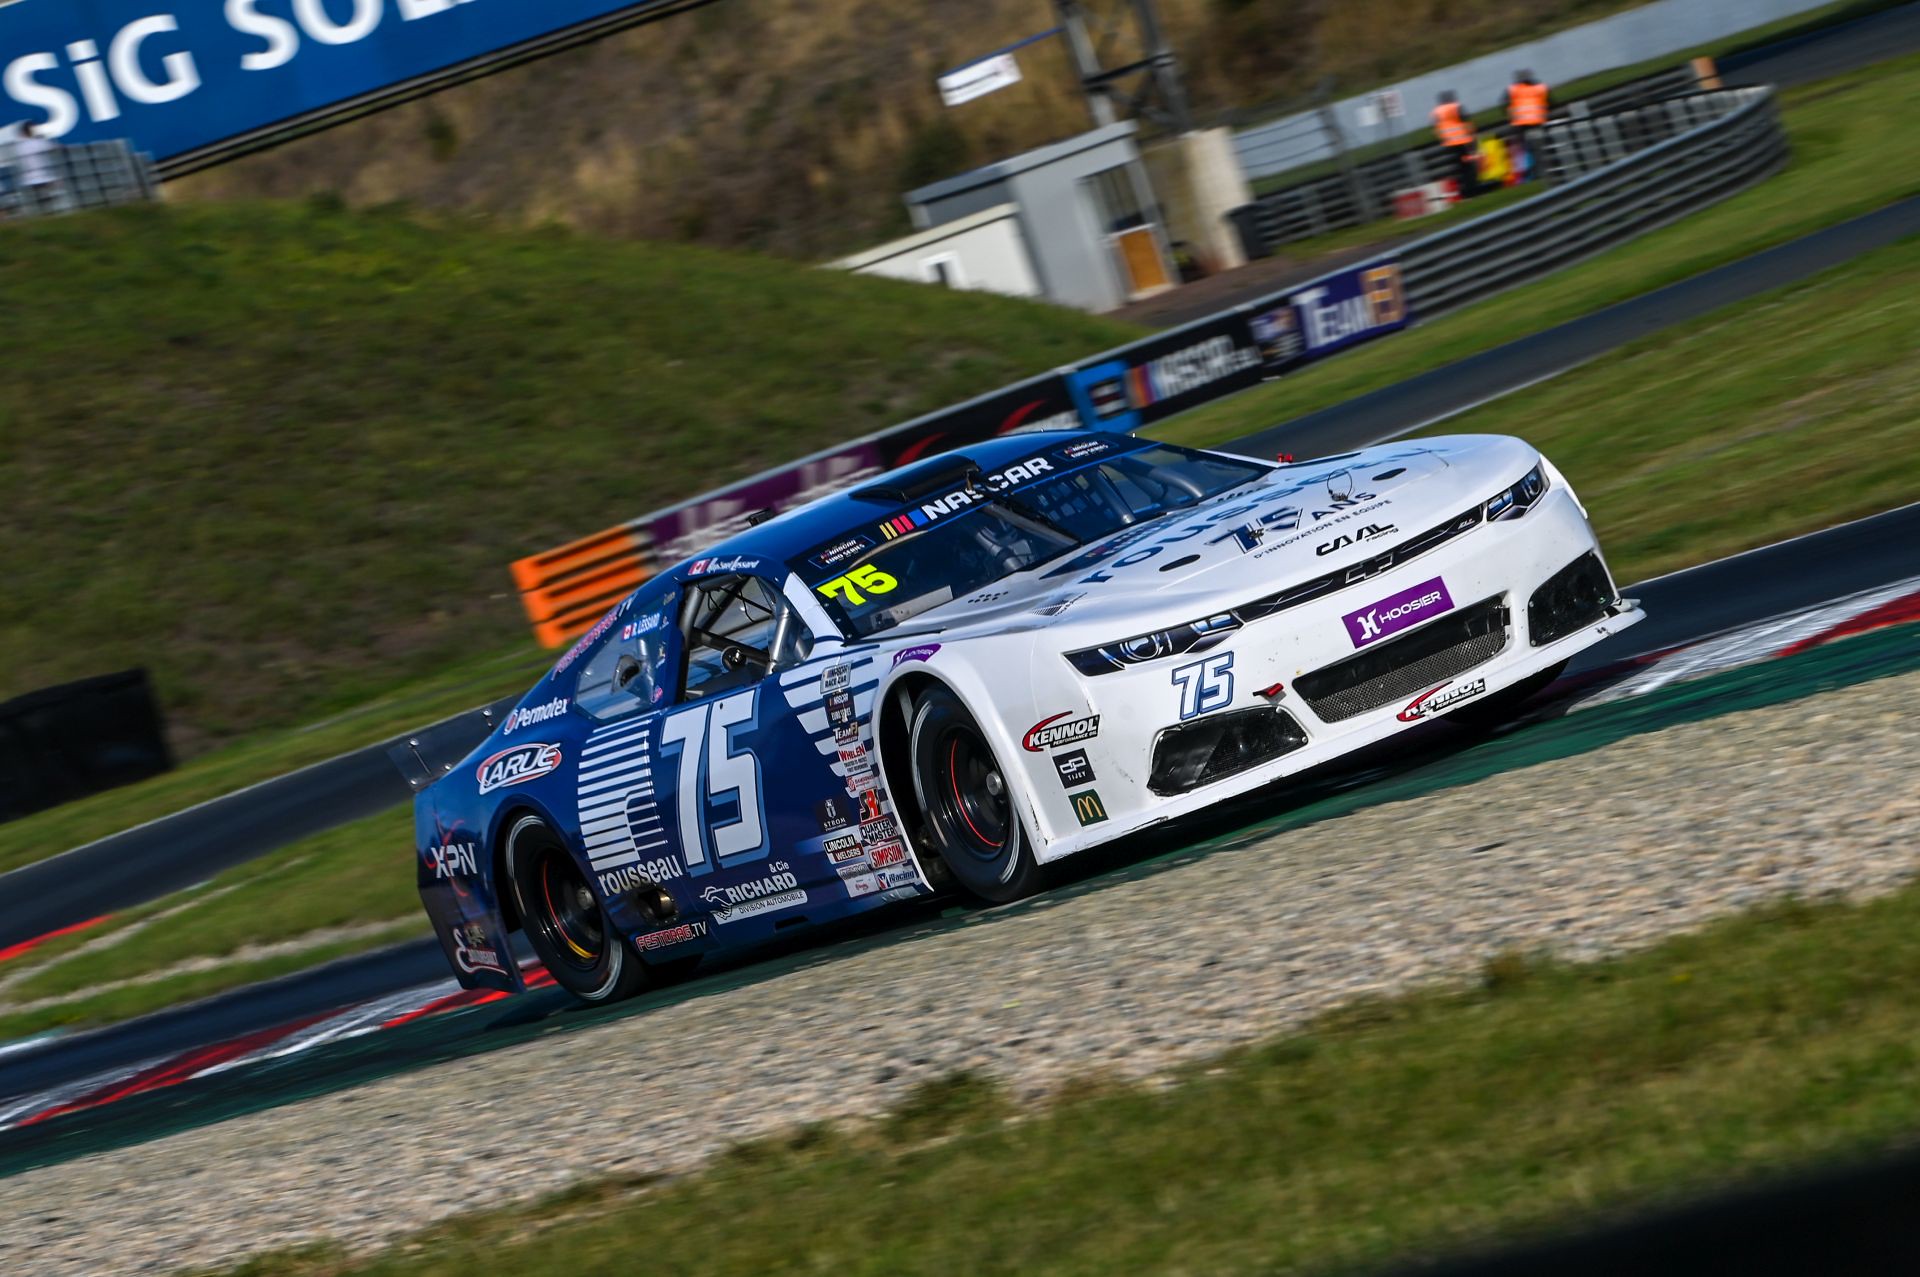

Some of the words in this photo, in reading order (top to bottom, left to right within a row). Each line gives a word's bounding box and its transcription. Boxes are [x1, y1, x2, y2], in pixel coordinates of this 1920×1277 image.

[3, 14, 203, 139] SiG
[224, 0, 474, 71] SO
[1312, 491, 1377, 521] ANS
[1204, 505, 1303, 555] 75
[1254, 520, 1334, 559] D'INNOVATION
[1334, 513, 1351, 524] EN
[816, 564, 898, 606] 75
[1379, 590, 1443, 624] HOOSIER
[1171, 650, 1235, 721] 75
[515, 696, 568, 730] Permatex
[1029, 720, 1097, 748] KENNOL
[1053, 732, 1089, 747] PERFORMANCE
[839, 742, 866, 762] WHELEN
[479, 742, 561, 796] LARUE
[660, 688, 769, 876] 75
[1067, 771, 1087, 781] TIJEY
[823, 817, 846, 829] STROM
[860, 820, 892, 839] QUARTER
[868, 827, 897, 845] MASTER
[824, 836, 855, 852] LINCOLN
[835, 847, 861, 861] WELDERS
[871, 844, 903, 868] SIMPSON
[598, 854, 683, 897] rousseau
[769, 863, 776, 873] &
[776, 860, 790, 872] Cie
[889, 870, 915, 882] iRacing
[725, 872, 797, 903] RICHARD
[739, 900, 766, 914] DIVISION
[766, 891, 805, 907] AUTOMOBILE
